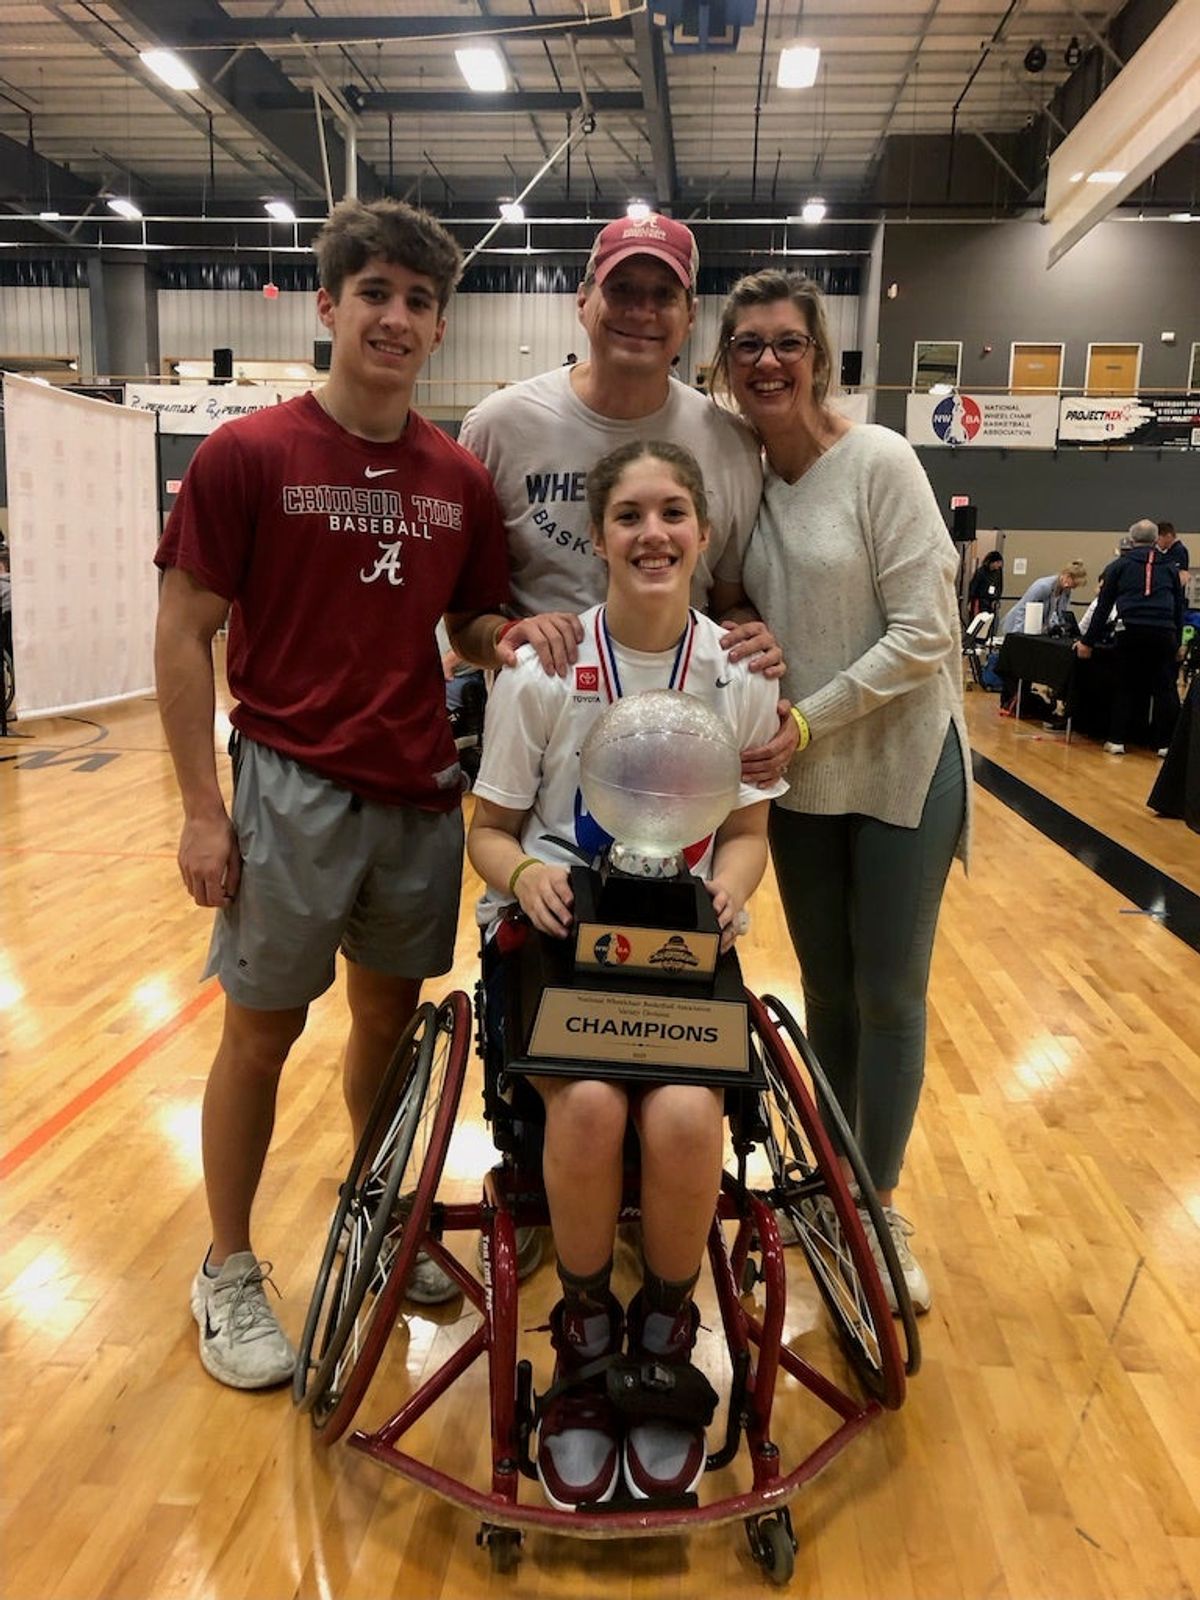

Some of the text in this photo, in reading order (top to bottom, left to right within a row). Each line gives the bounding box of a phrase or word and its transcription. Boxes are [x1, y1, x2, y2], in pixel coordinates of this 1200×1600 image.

[934, 414, 981, 424] NW BA
[282, 485, 463, 531] CRIMSON TIDE
[329, 515, 433, 540] BASEBALL
[532, 509, 597, 556] BASK
[359, 540, 403, 586] A
[573, 695, 600, 703] TOYOTA
[565, 1016, 719, 1043] CHAMPIONS
